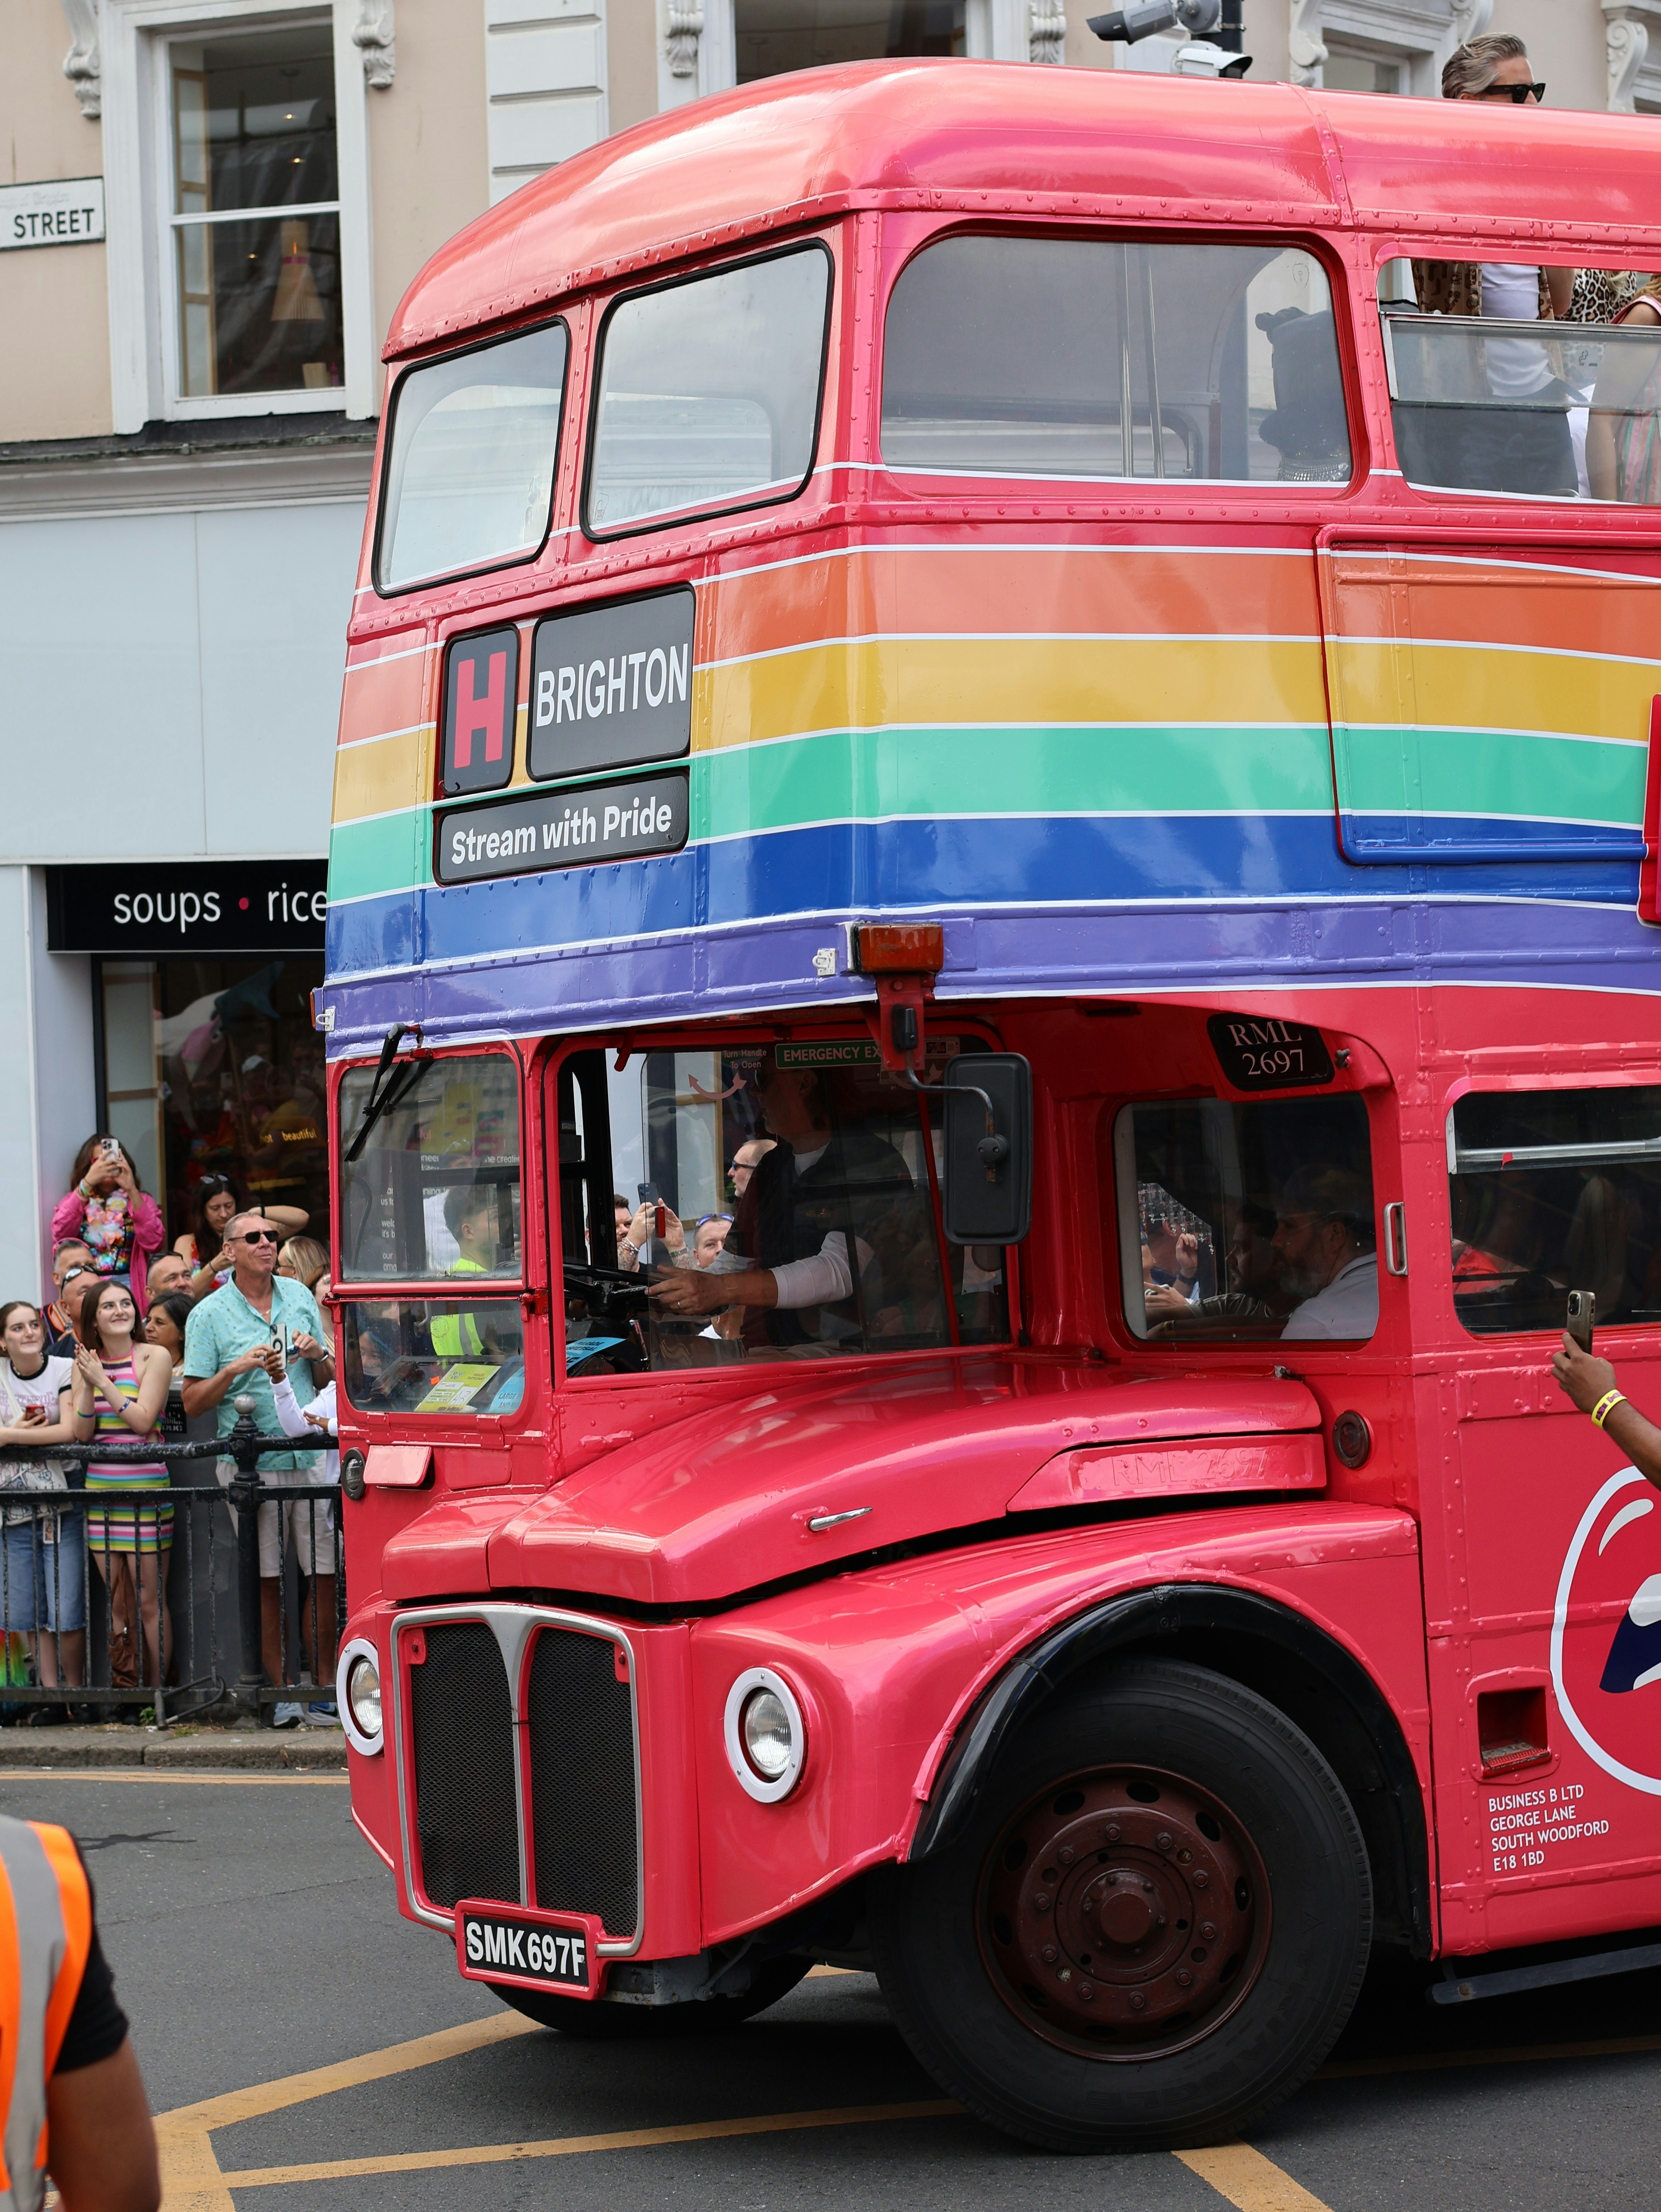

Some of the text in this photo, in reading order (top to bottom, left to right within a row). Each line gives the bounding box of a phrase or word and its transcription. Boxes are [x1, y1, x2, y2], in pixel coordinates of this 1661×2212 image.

[14, 208, 95, 239] STREET
[454, 643, 688, 769] H BRIGHTON
[451, 796, 672, 864] Stream with Pride
[113, 883, 327, 933] soups rice
[1226, 1020, 1302, 1047] RML
[723, 1049, 767, 1058] Turn Handle
[730, 1060, 762, 1069] To Open
[784, 1046, 861, 1062] EMERGENCY
[1242, 1049, 1303, 1075] 2697
[282, 1128, 317, 1141] beautiful
[1488, 1784, 1584, 1812] BUSINESS B LTD
[1490, 1805, 1576, 1832] GEORGE LANE
[1491, 1820, 1609, 1852] SOUTH WOODFORD
[1494, 1850, 1545, 1872] E18 1BD
[466, 1921, 585, 1977] SMK697F
